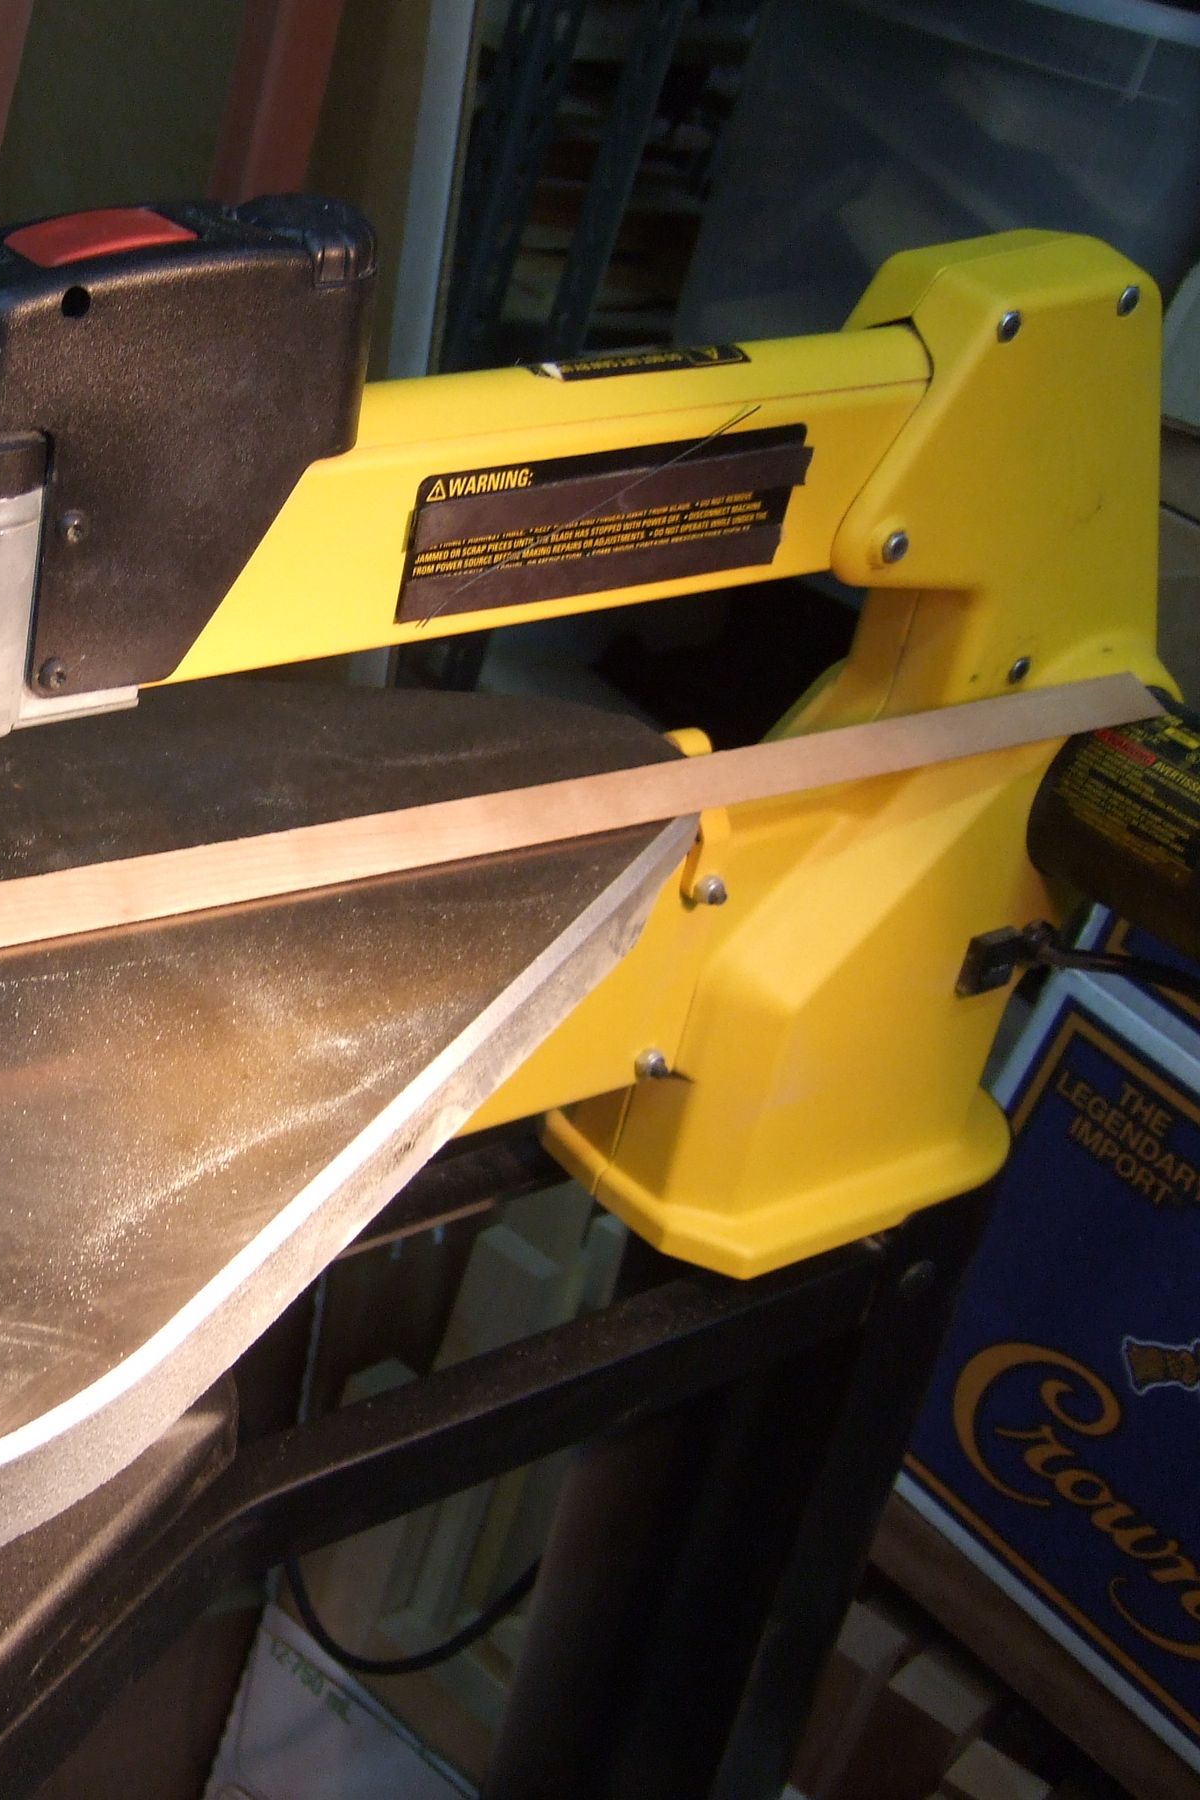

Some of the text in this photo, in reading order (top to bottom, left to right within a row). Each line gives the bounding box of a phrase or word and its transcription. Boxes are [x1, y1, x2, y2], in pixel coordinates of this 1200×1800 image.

[449, 468, 533, 497] WARNING:
[413, 564, 434, 575] FROM
[436, 560, 462, 571] POWER
[464, 555, 492, 567] SOURCE
[522, 546, 551, 557] MAKING
[553, 541, 582, 552] REPAIRS
[583, 539, 593, 548] OR
[594, 531, 645, 546] ADJUSTMENTS
[654, 528, 664, 537] DO
[665, 526, 679, 535] NOT
[680, 521, 709, 532] OPERATE
[711, 517, 730, 527] WHILE
[732, 514, 754, 524] UNDER
[756, 512, 767, 520] THE
[416, 550, 449, 563] JAMMED
[450, 548, 461, 558] OR
[462, 544, 486, 556] SCRAP
[487, 540, 512, 552] PIECES
[550, 531, 573, 542] BLADE
[574, 529, 589, 538] HAS
[590, 524, 621, 536] STOPPED
[623, 520, 641, 530] WITH
[642, 516, 666, 527] POWER
[688, 507, 730, 520] DISCONNECT
[731, 502, 761, 513] MACHINE
[1056, 1071, 1200, 1202] LEGENDAR
[1120, 1082, 1173, 1138] THE
[1070, 1115, 1174, 1207] IMPORT
